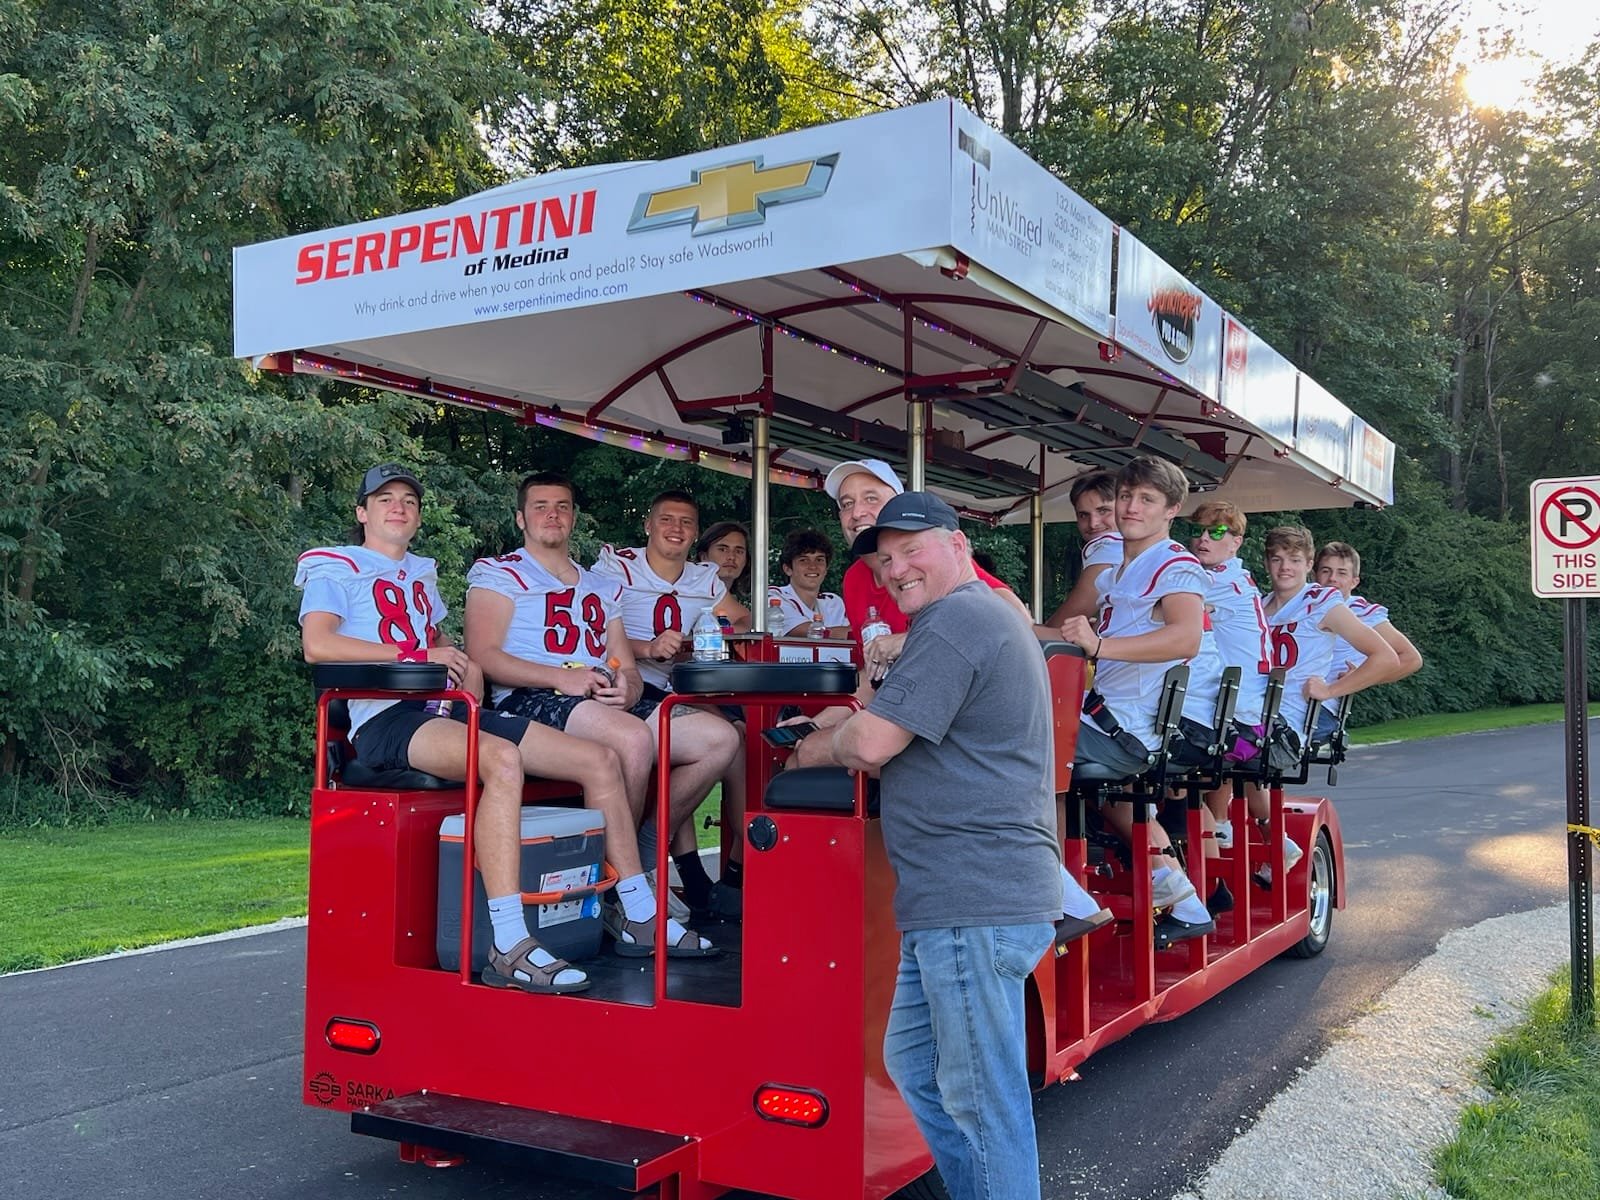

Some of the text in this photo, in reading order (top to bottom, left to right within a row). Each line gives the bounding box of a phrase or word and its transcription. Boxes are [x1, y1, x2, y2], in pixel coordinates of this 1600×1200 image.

[977, 176, 1042, 248] UnWined
[296, 190, 597, 285] SERPENTINI
[986, 219, 1033, 257] MAIN STREET
[354, 231, 774, 316] Why drink and drive when you can drink and pedal? Stay safe Wadsworth!
[464, 247, 570, 276] of Medina
[474, 282, 629, 316] www.serpentinimedina.com
[1552, 553, 1597, 569] THIS
[1552, 573, 1598, 588] SIDE
[544, 588, 606, 658] 53
[347, 1081, 395, 1101] SARKA
